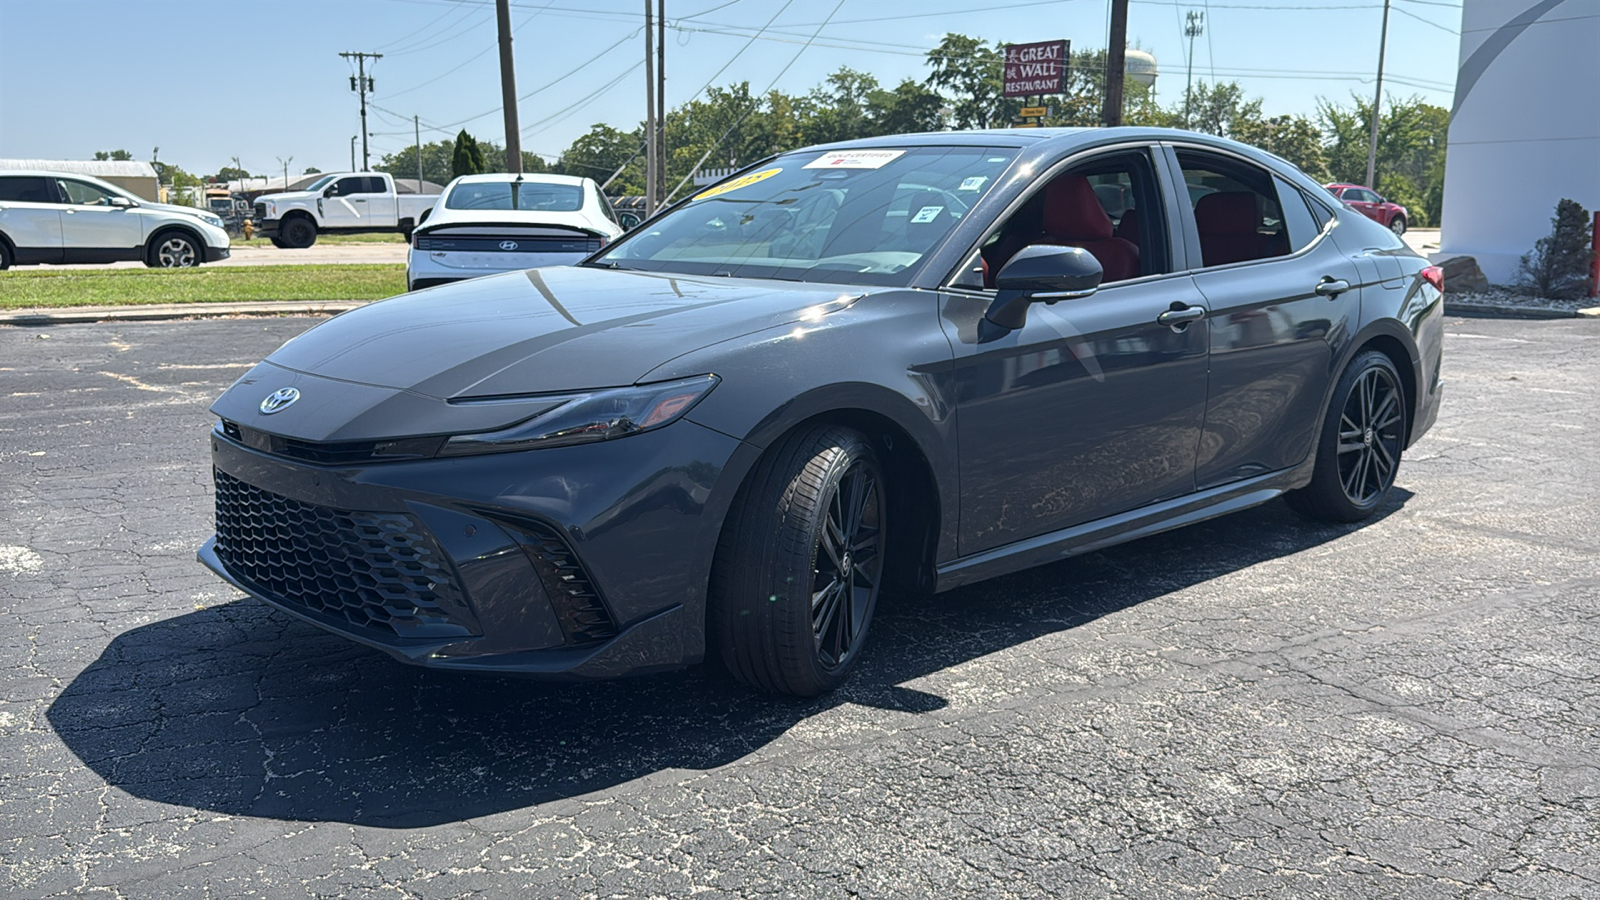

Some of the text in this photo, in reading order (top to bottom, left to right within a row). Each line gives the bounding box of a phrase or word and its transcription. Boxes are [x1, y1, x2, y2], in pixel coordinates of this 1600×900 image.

[1020, 45, 1061, 62] GREAT
[1020, 62, 1057, 78] WALL
[1005, 79, 1059, 93] RESTAURANT
